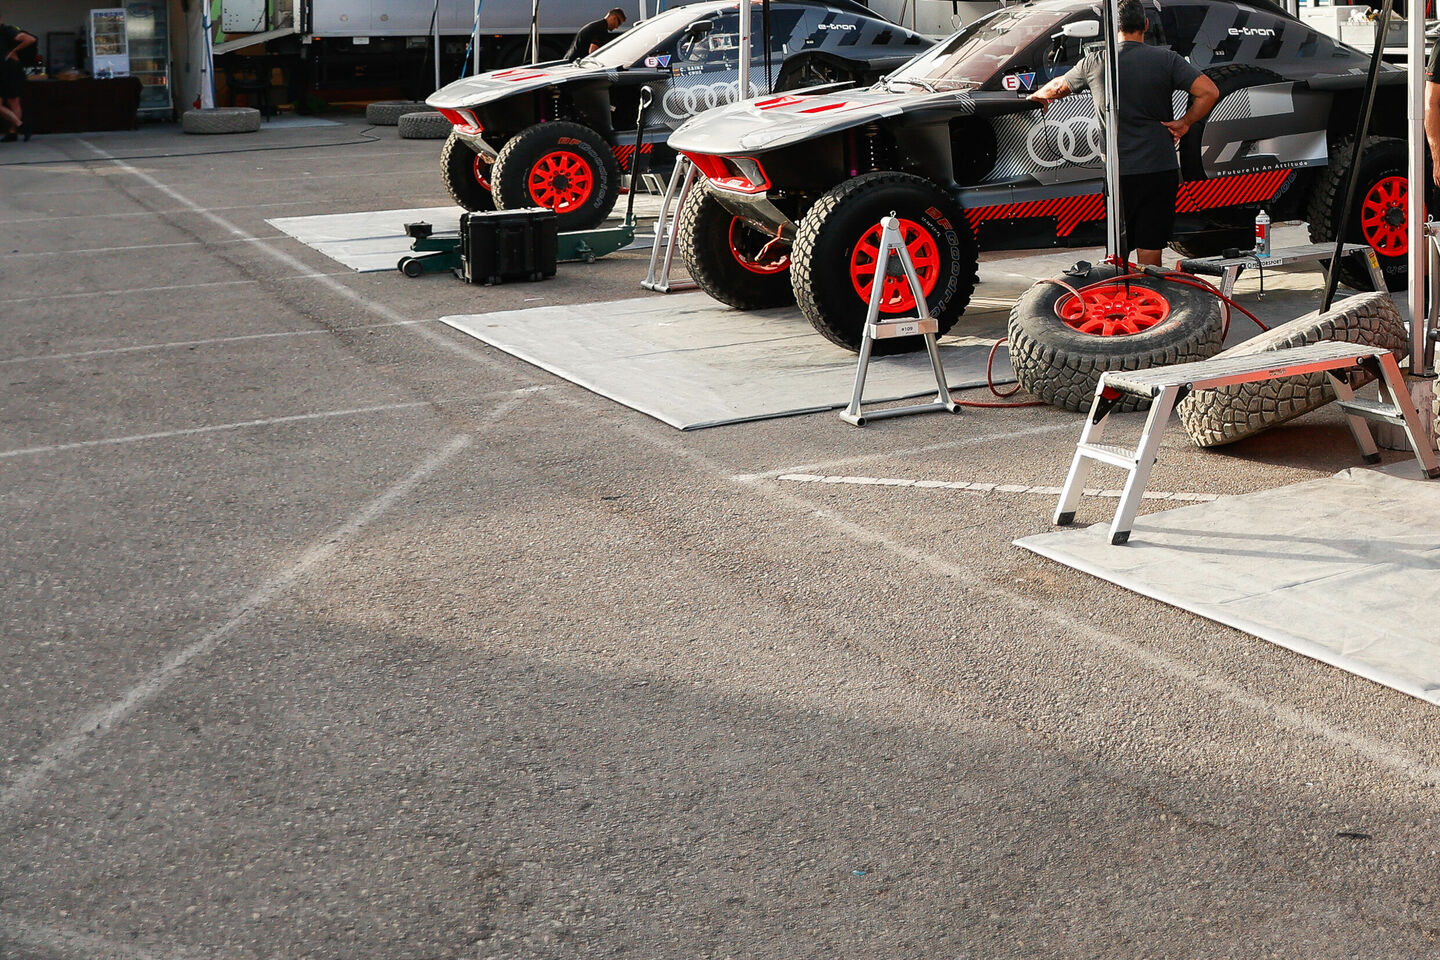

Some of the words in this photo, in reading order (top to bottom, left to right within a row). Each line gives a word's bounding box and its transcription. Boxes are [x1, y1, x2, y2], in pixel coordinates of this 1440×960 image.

[817, 23, 857, 31] e-tron
[1227, 26, 1276, 36] e-tron
[1006, 77, 1017, 89] E
[925, 206, 960, 317] BFGoodric
[1252, 259, 1282, 267] MOORSPORT
